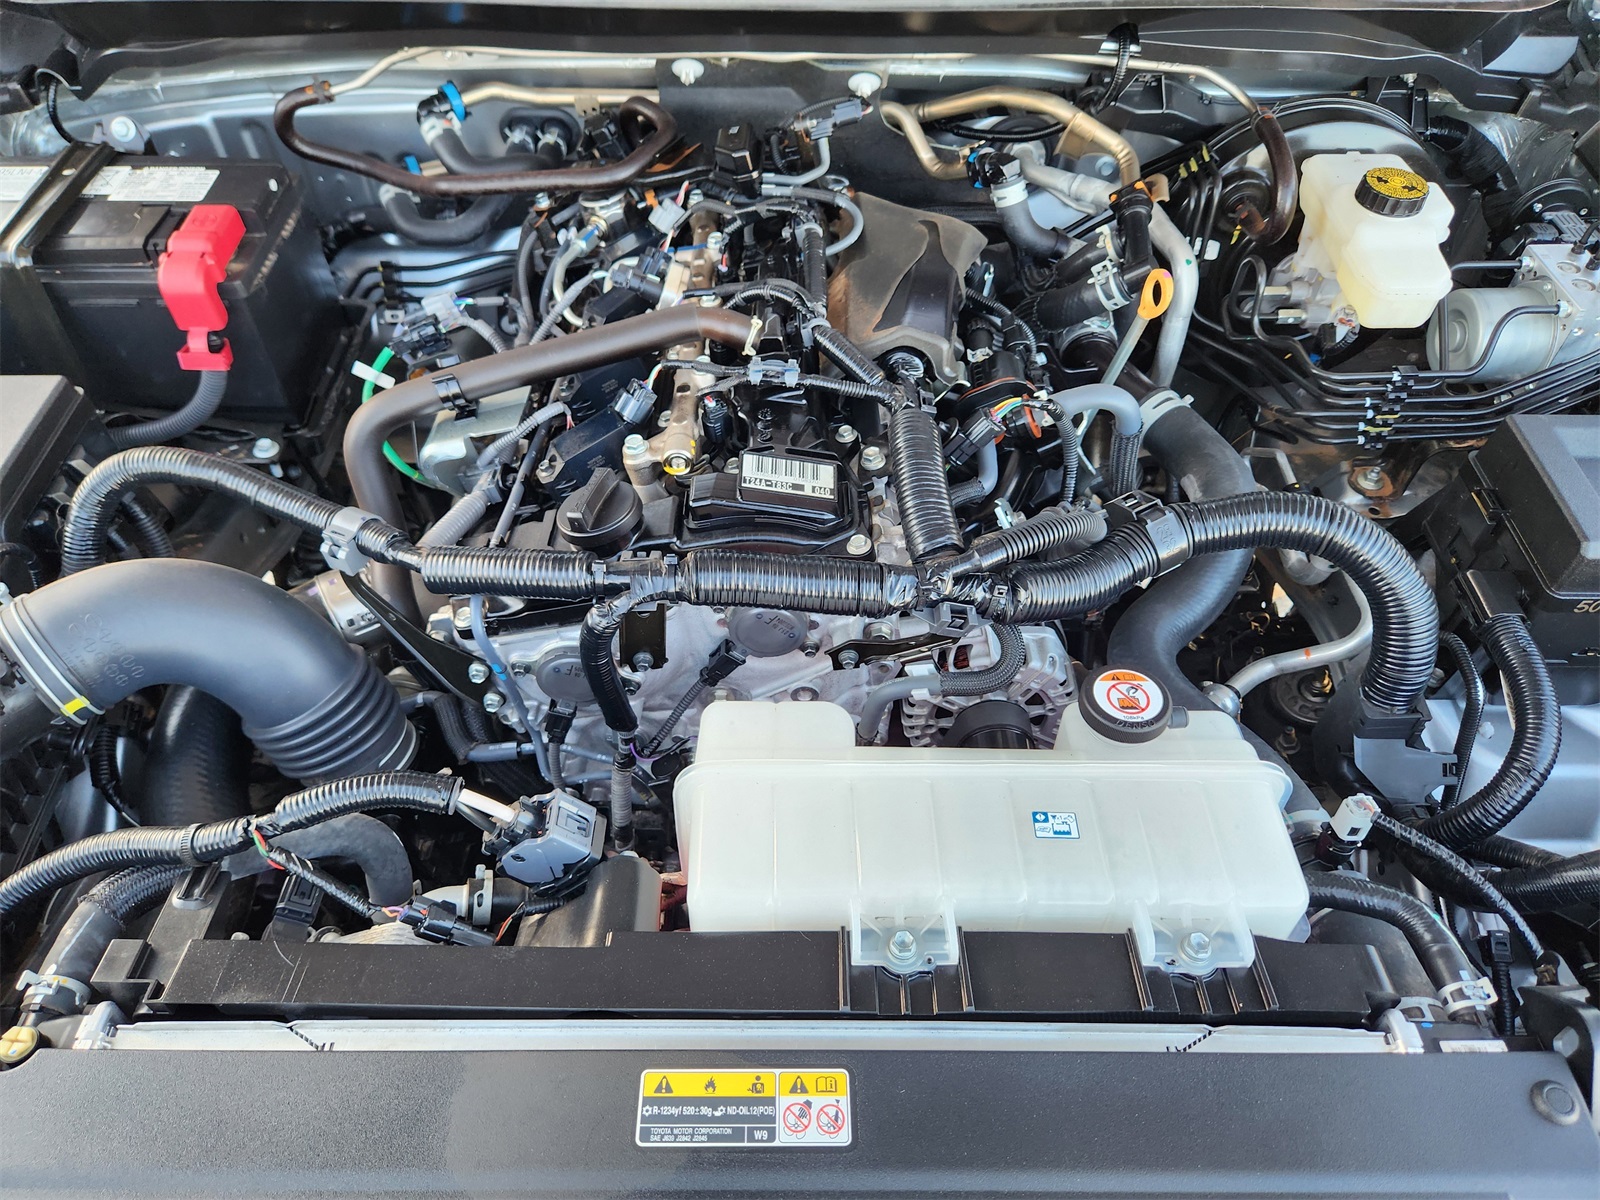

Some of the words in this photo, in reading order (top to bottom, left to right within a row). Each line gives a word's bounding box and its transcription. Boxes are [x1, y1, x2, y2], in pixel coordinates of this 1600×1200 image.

[744, 477, 793, 491] T24A-T83C
[814, 487, 831, 496] 040
[1115, 719, 1155, 729] DENSO
[652, 1105, 682, 1117] R-1234yf
[683, 1105, 713, 1117] 520±30g
[727, 1105, 776, 1117] ND-OIL12(POE)
[754, 1129, 768, 1141] W9
